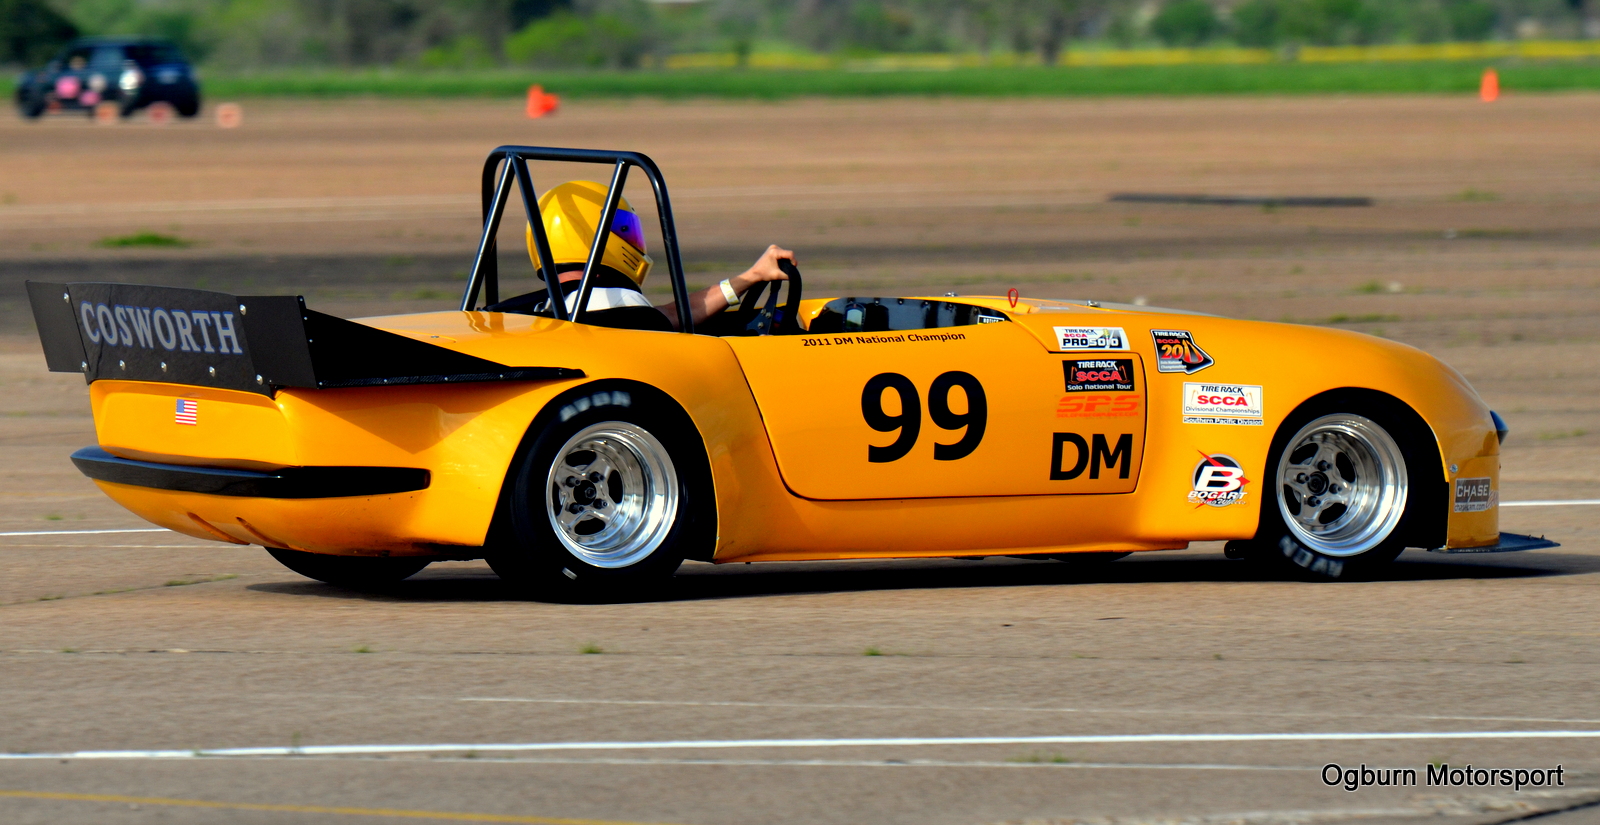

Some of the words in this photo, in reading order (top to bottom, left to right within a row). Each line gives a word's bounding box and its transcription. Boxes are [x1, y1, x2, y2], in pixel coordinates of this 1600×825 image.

[80, 301, 243, 354] COSWORTH
[801, 338, 832, 347] 2011
[834, 337, 854, 345] DM
[856, 334, 905, 344] National
[907, 332, 966, 343] Champion
[1096, 361, 1118, 371] RACK
[1076, 371, 1122, 381] SCCA
[1221, 387, 1244, 396] RACK
[1056, 395, 1140, 412] SPS
[1197, 395, 1248, 406] SCCA
[861, 370, 988, 463] 99
[1050, 432, 1133, 480] DM
[1194, 466, 1243, 492] B
[1187, 491, 1248, 499] BOGART
[1457, 485, 1489, 497] CHASE
